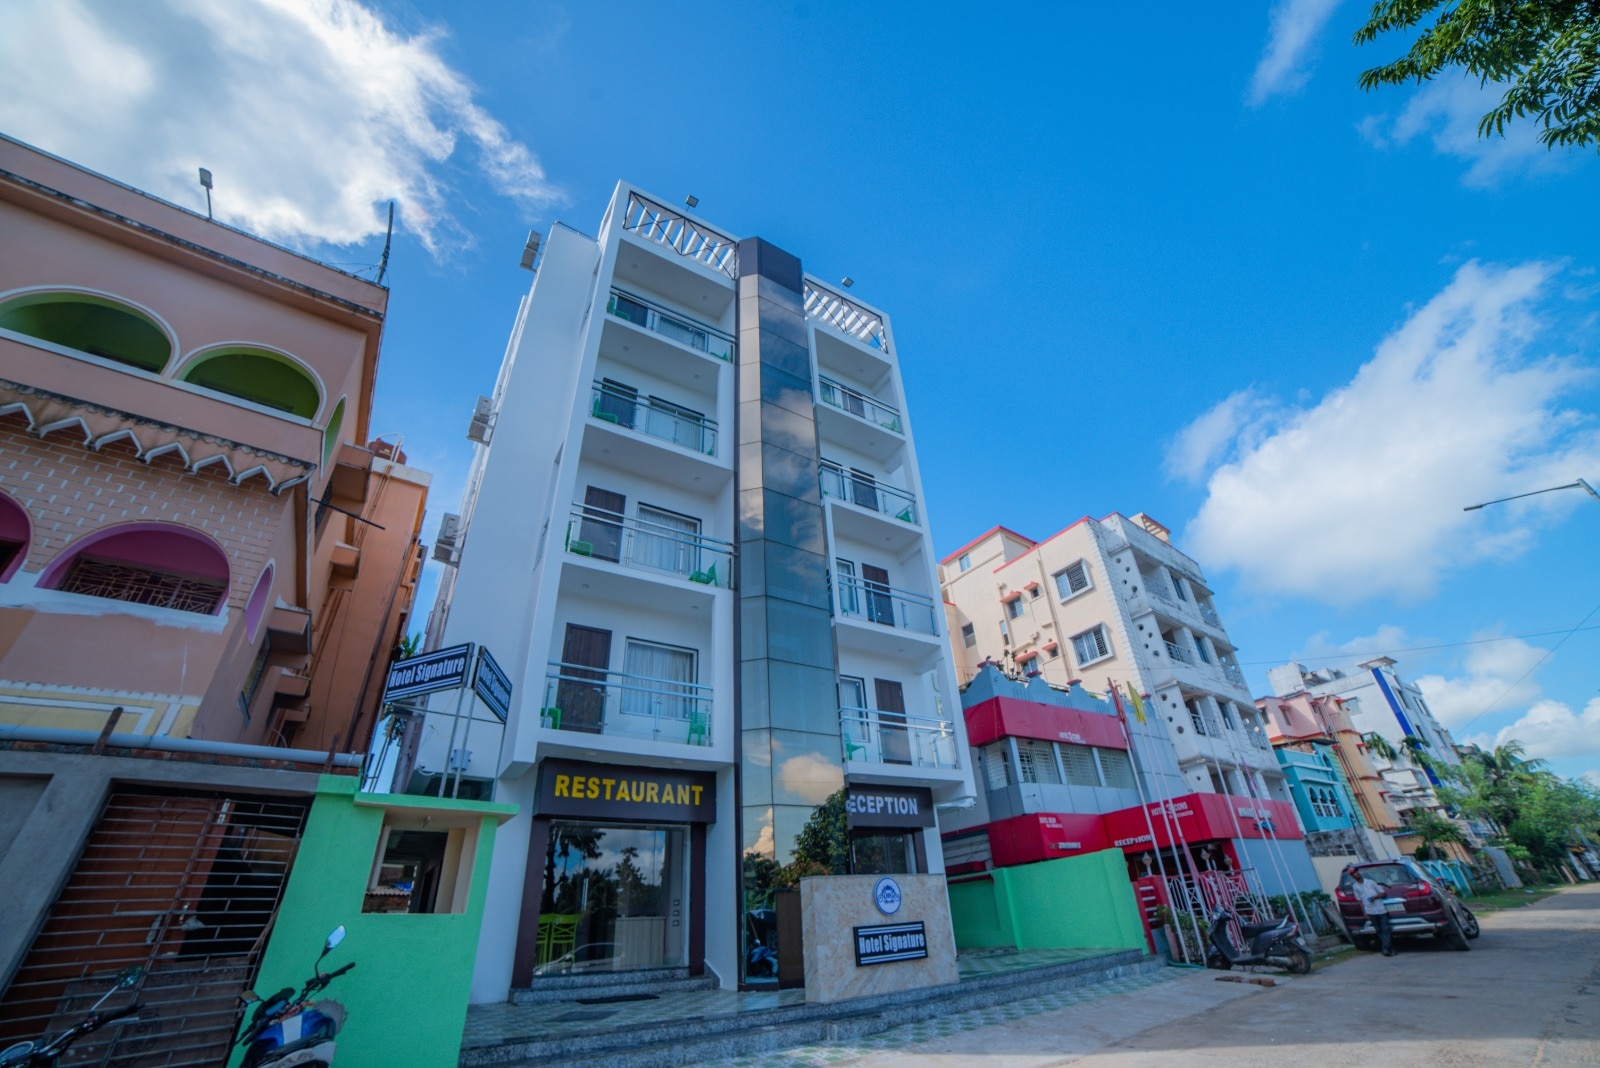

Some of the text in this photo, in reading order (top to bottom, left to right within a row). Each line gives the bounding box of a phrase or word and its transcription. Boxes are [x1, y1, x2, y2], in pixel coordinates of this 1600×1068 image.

[389, 657, 465, 688] Hotel Signature
[555, 775, 704, 806] RESTAURANT
[859, 933, 925, 954] Hotel Signature
